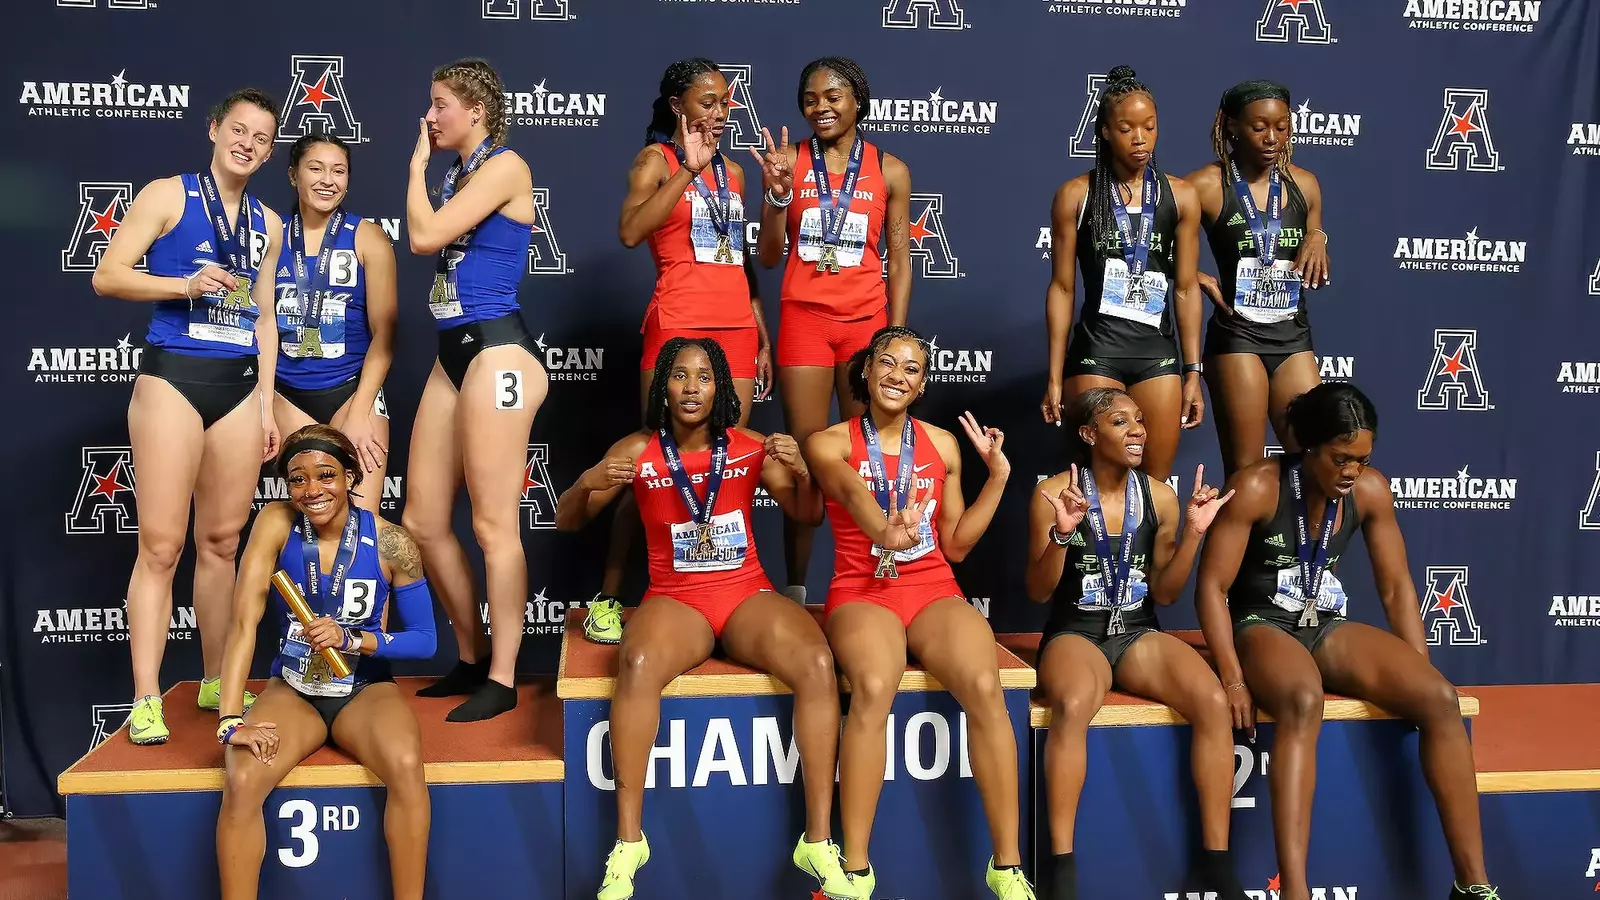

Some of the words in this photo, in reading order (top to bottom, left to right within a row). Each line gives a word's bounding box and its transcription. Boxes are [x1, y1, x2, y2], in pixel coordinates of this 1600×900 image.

[1049, 5, 1103, 15] ATHLETIC
[1106, 7, 1182, 18] CONFERENCE
[1403, 0, 1542, 22] AMERICAN
[1409, 21, 1460, 31] ATHLETIC
[1463, 22, 1534, 33] CONFERENCE
[20, 82, 190, 108] AMERICAN
[502, 92, 606, 117] ERICAN
[28, 108, 91, 117] ATHLETIC
[95, 109, 183, 119] CONFERENCE
[517, 117, 600, 128] CONFERENCE
[860, 99, 998, 124] MERICAN
[913, 125, 992, 135] CONFERENCE
[1290, 136, 1355, 147] ONFERENCE
[1426, 88, 1499, 172] A
[203, 176, 217, 202] AMERICAN
[800, 188, 874, 201] HOSON
[216, 215, 230, 242] AMERICAN
[252, 233, 267, 269] 3
[1393, 238, 1527, 263] AMERICAN
[336, 251, 352, 285] 3
[1399, 262, 1449, 271] ATHLETIC
[1452, 263, 1520, 273] CONFERENCE
[35, 374, 96, 383] ATHLETIC
[929, 374, 987, 383] NFERENCE
[1417, 329, 1489, 411] A
[501, 371, 519, 408] 3
[640, 462, 658, 478] A
[646, 466, 750, 489] HOSON
[682, 486, 699, 515] AMERICAN
[1390, 477, 1518, 500] AMERICAN
[1394, 501, 1440, 509] ATHLETIC
[1443, 501, 1511, 510] CONFERENCE
[309, 561, 318, 594] AMERICAN
[331, 563, 344, 596] AMERICAN
[348, 582, 369, 618] 3
[1420, 566, 1481, 646] A
[41, 634, 102, 643] ATHLETIC
[108, 632, 192, 642] CONNCE
[586, 711, 974, 792] CHAMIO
